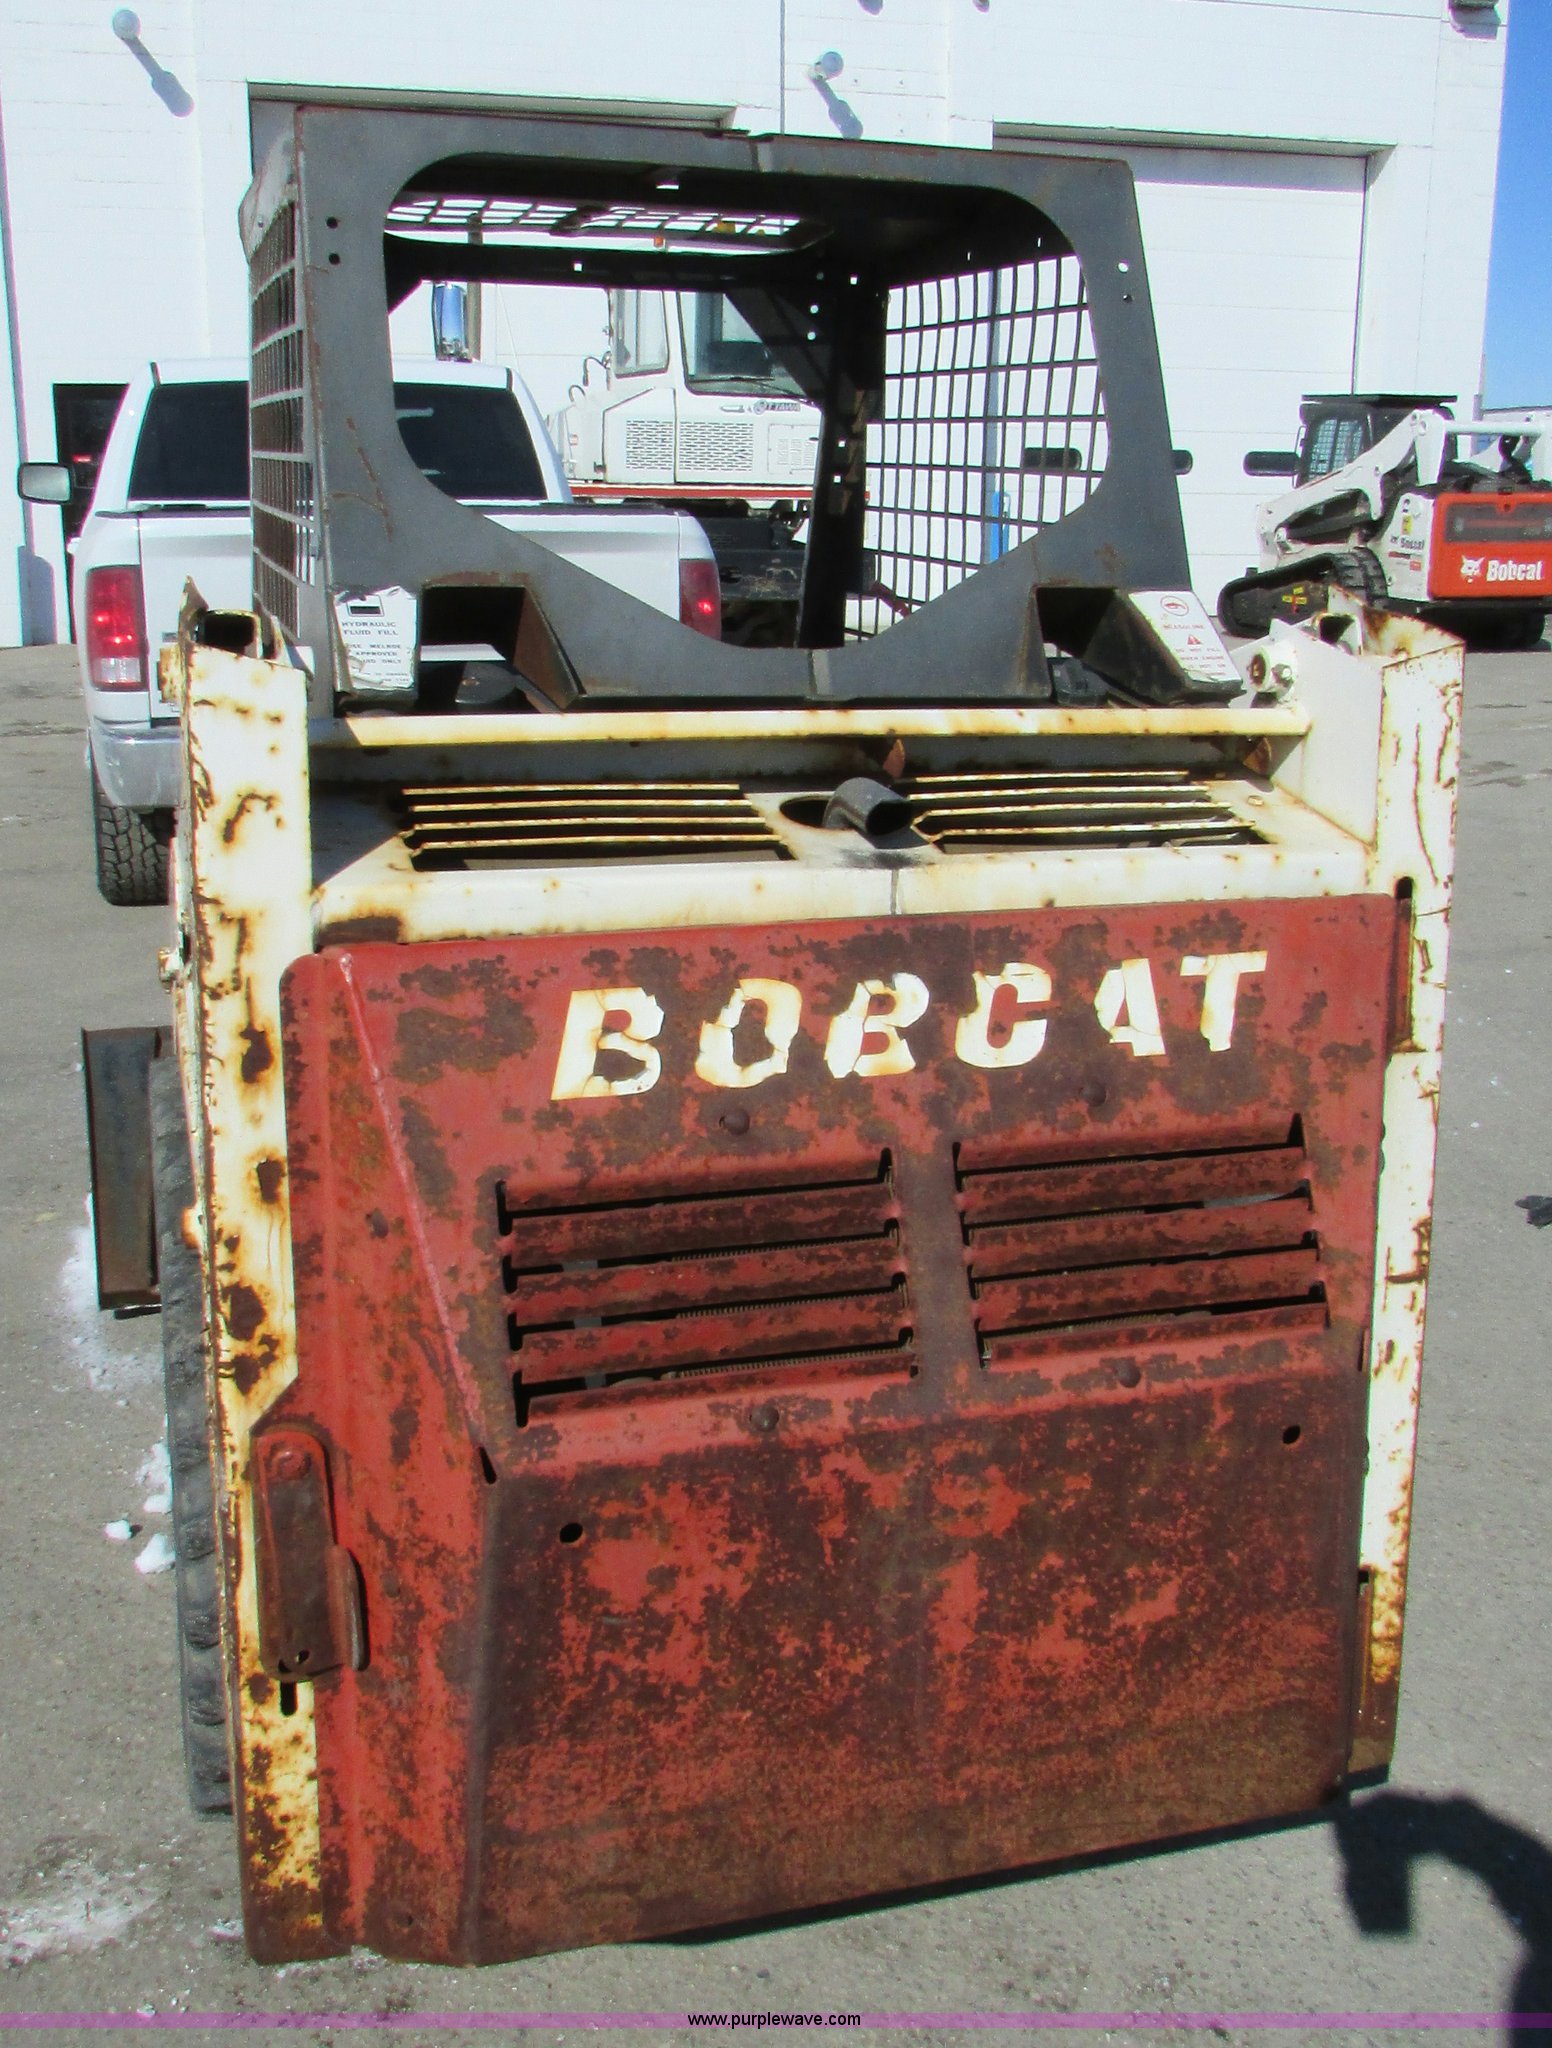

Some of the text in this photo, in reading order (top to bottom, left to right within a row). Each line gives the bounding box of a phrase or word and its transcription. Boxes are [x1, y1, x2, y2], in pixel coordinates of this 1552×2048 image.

[1486, 559, 1543, 582] Bobcat
[378, 629, 399, 637] FILL
[551, 950, 1268, 1101] BOBCAT
